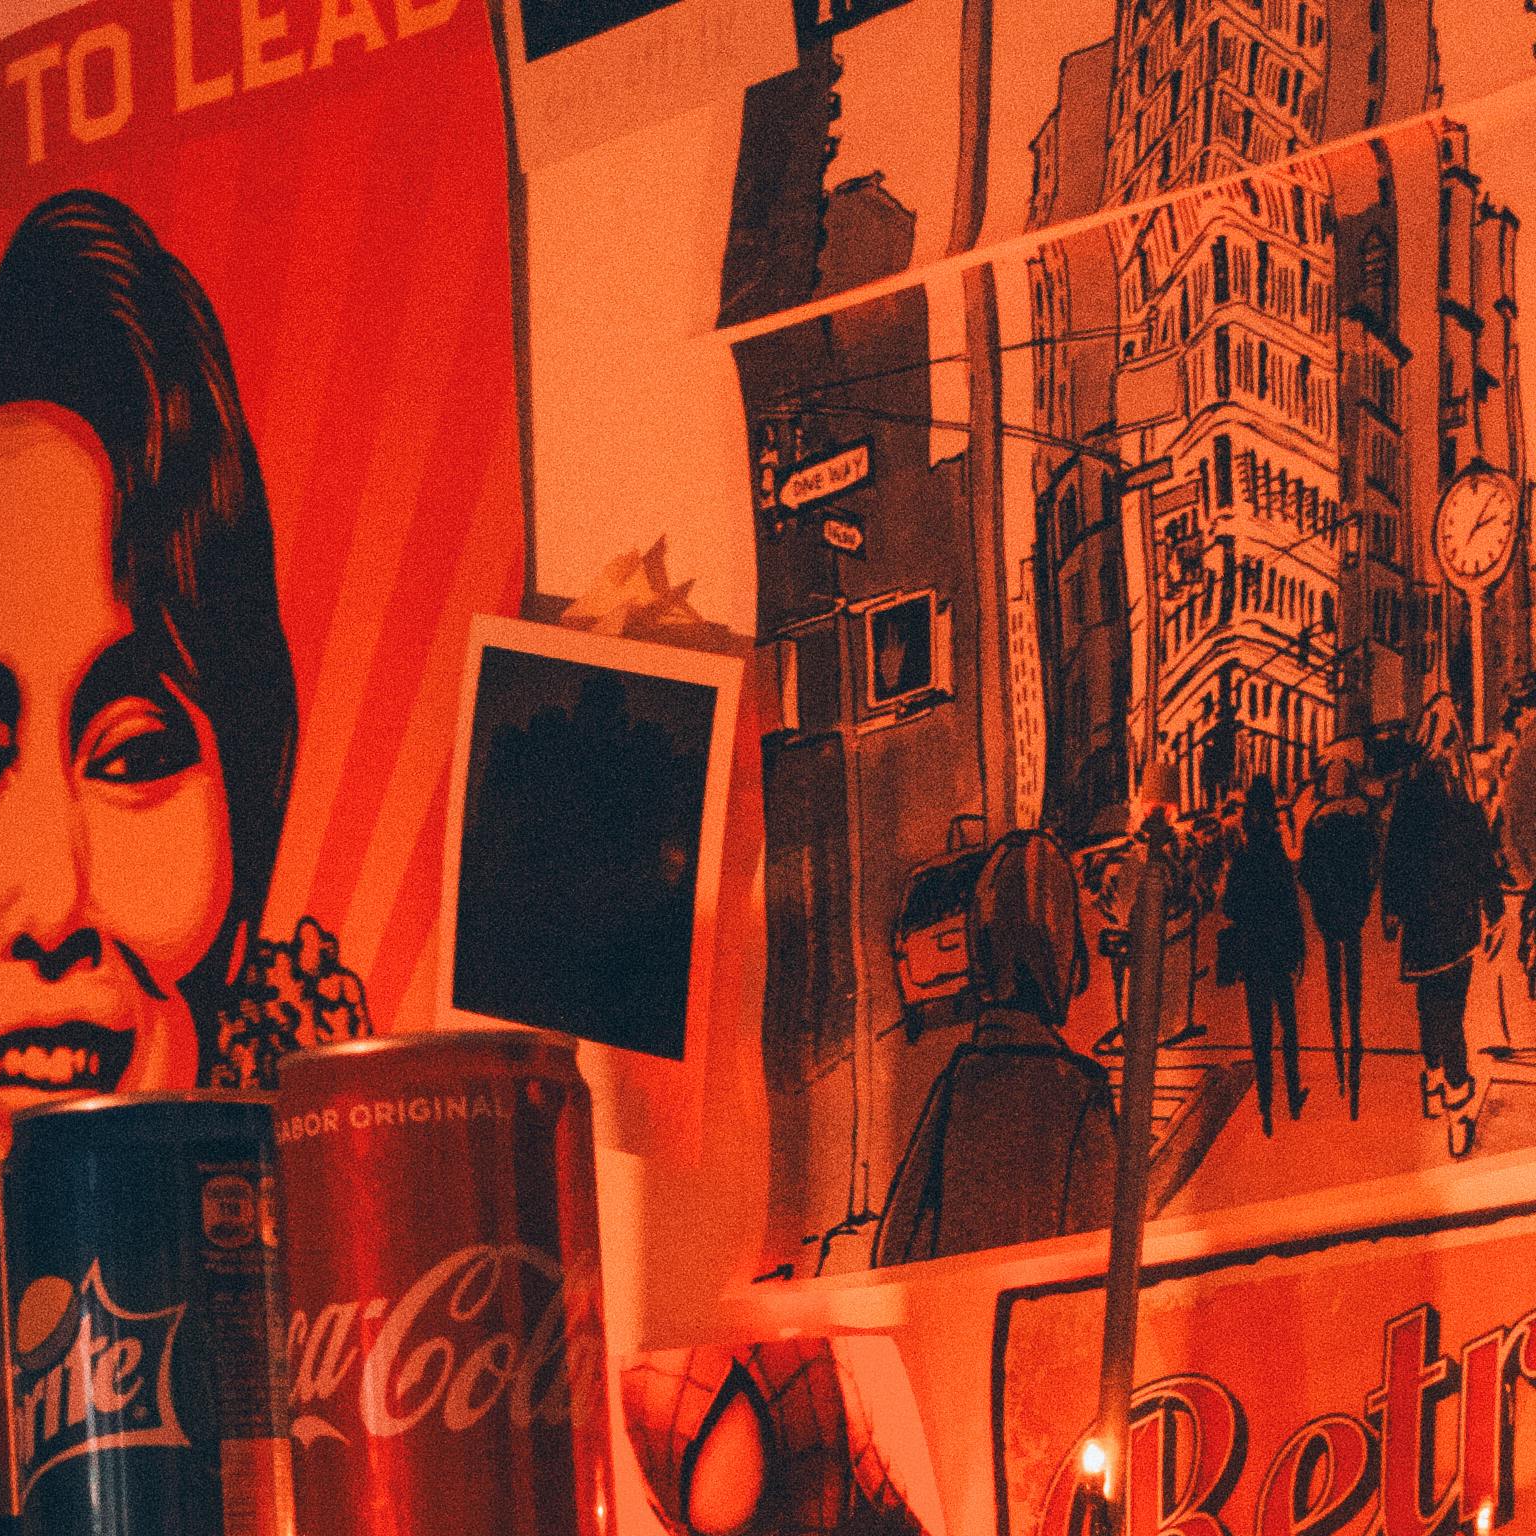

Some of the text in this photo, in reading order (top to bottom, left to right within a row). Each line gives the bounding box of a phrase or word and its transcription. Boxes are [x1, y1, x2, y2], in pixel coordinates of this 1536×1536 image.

[7, 22, 134, 165] TO
[792, 451, 864, 498] ONE WAY
[277, 1094, 510, 1144] ABOR ORIGINAL
[16, 1313, 145, 1466] rite
